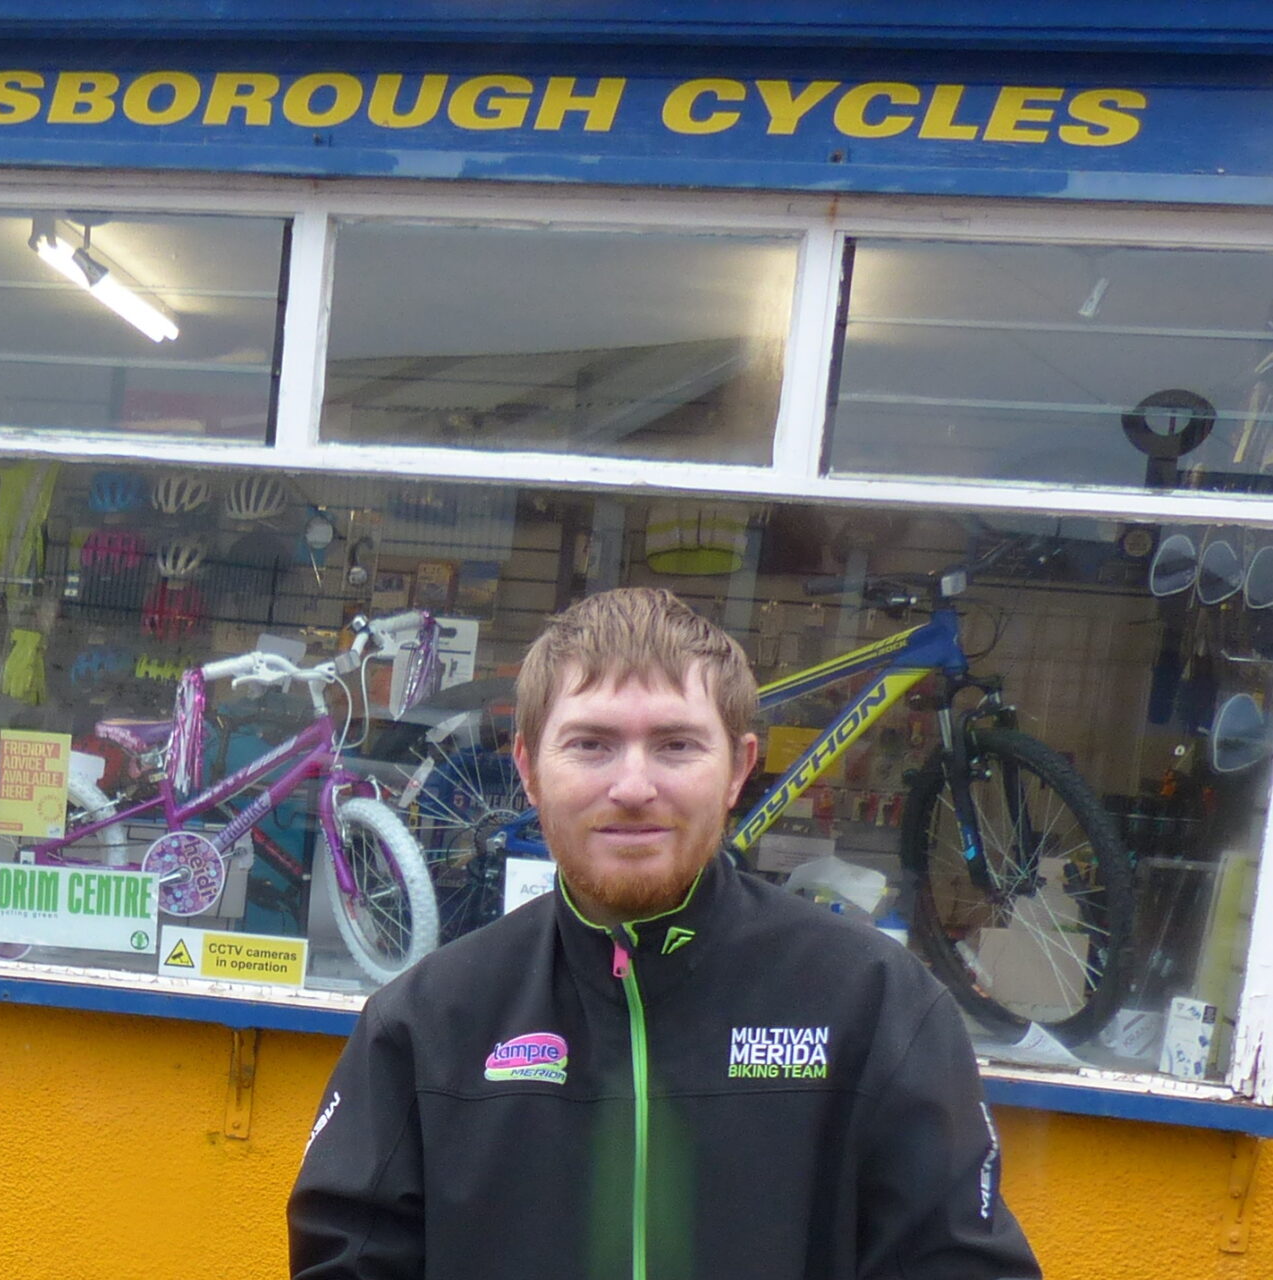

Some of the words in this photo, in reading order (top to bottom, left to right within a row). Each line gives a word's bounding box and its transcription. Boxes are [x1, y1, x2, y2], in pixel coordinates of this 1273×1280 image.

[661, 78, 1147, 147] CYCLES
[4, 741, 55, 757] FRIENDLY
[2, 757, 43, 771] ADVICE
[742, 682, 889, 846] PYTHON
[2, 771, 59, 786] AVAILABLE
[1, 784, 29, 799] HERE
[67, 871, 153, 919] CENTRE
[209, 943, 243, 955] CCTV
[246, 949, 297, 961] cameras
[216, 957, 227, 967] in
[230, 960, 288, 973] operation
[731, 1027, 828, 1045] MULTIVAN
[730, 1044, 827, 1066] MERIDA
[510, 1068, 565, 1081] MERIDA
[728, 1065, 779, 1078] BIKING
[781, 1065, 827, 1078] TEAM
